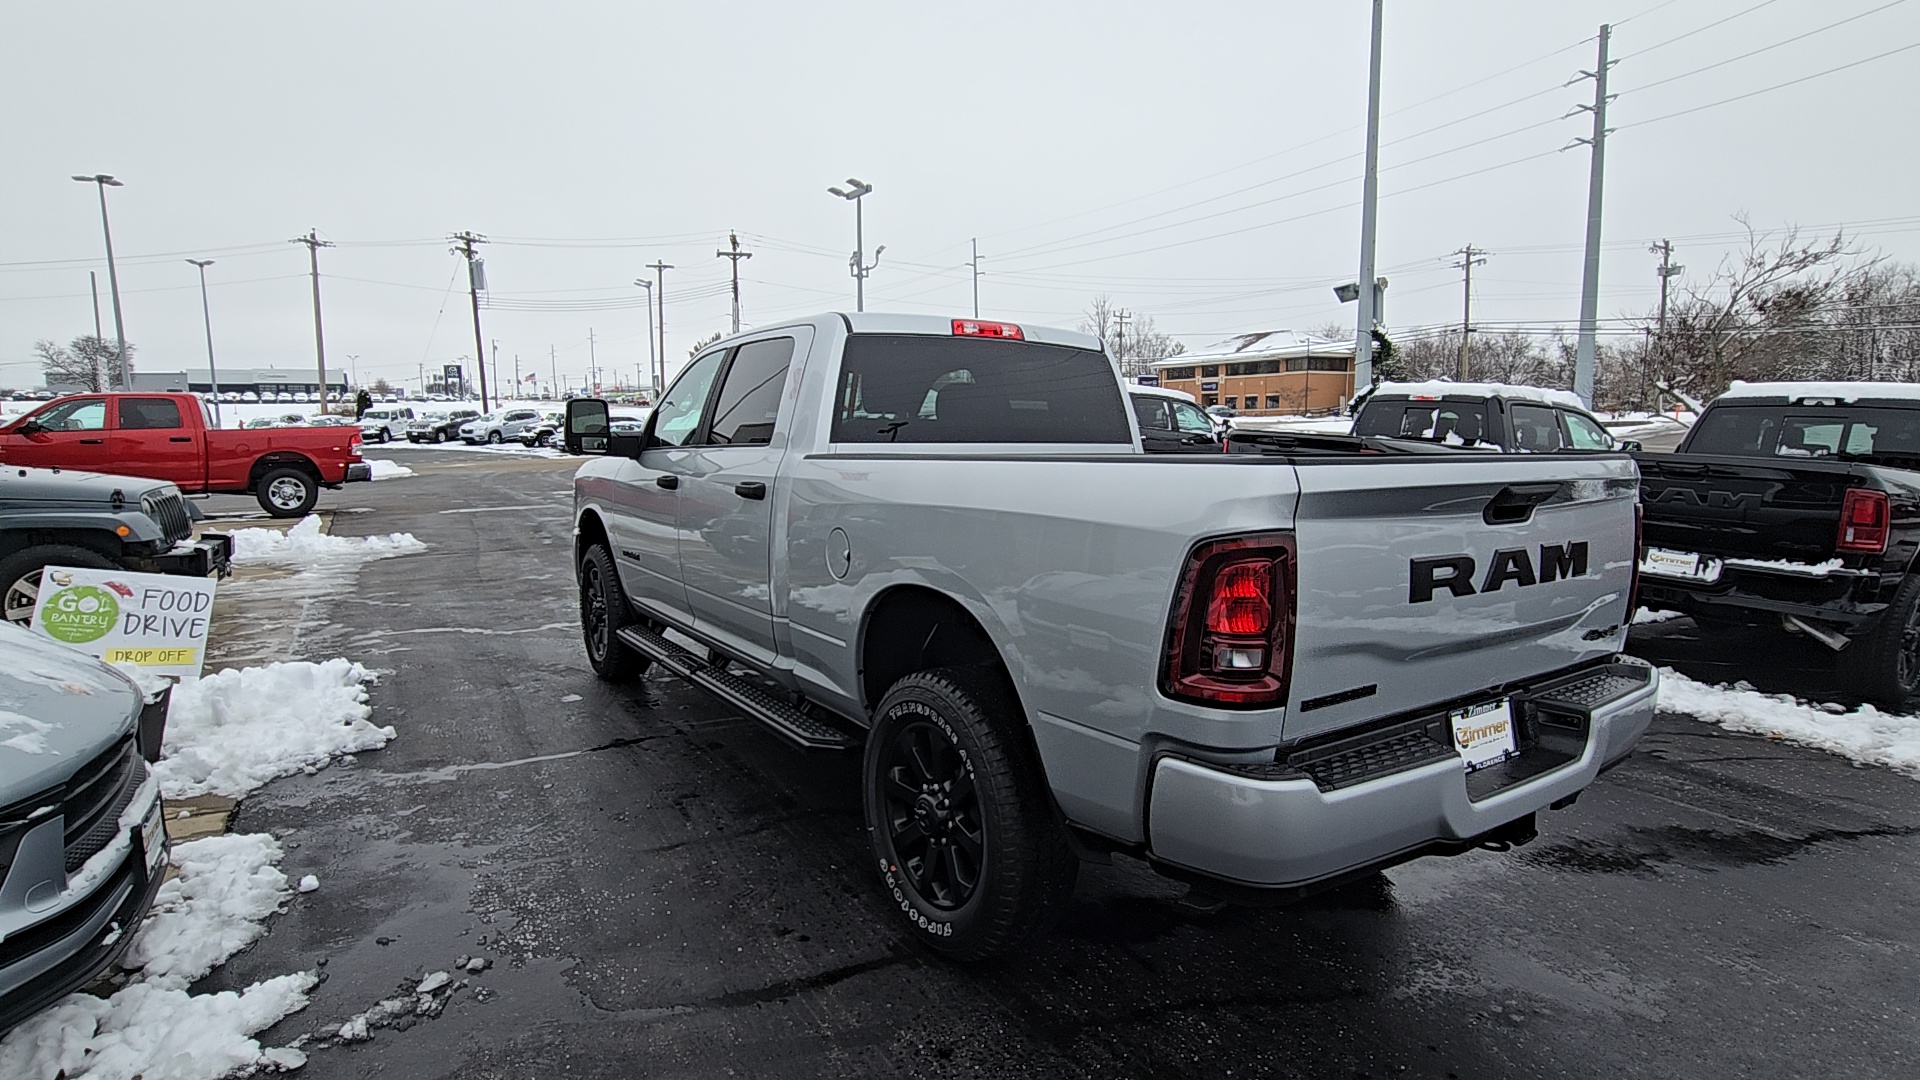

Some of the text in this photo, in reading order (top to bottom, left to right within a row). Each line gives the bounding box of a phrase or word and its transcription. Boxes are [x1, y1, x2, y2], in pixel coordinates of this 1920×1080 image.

[1409, 540, 1588, 604] RAM
[141, 588, 210, 613] FOOD
[51, 613, 108, 628] PANTRY
[123, 612, 206, 639] DRIVE
[114, 650, 188, 663] DROP OFF
[1458, 719, 1510, 746] Zimmer
[1475, 755, 1506, 770] FLORENCE
